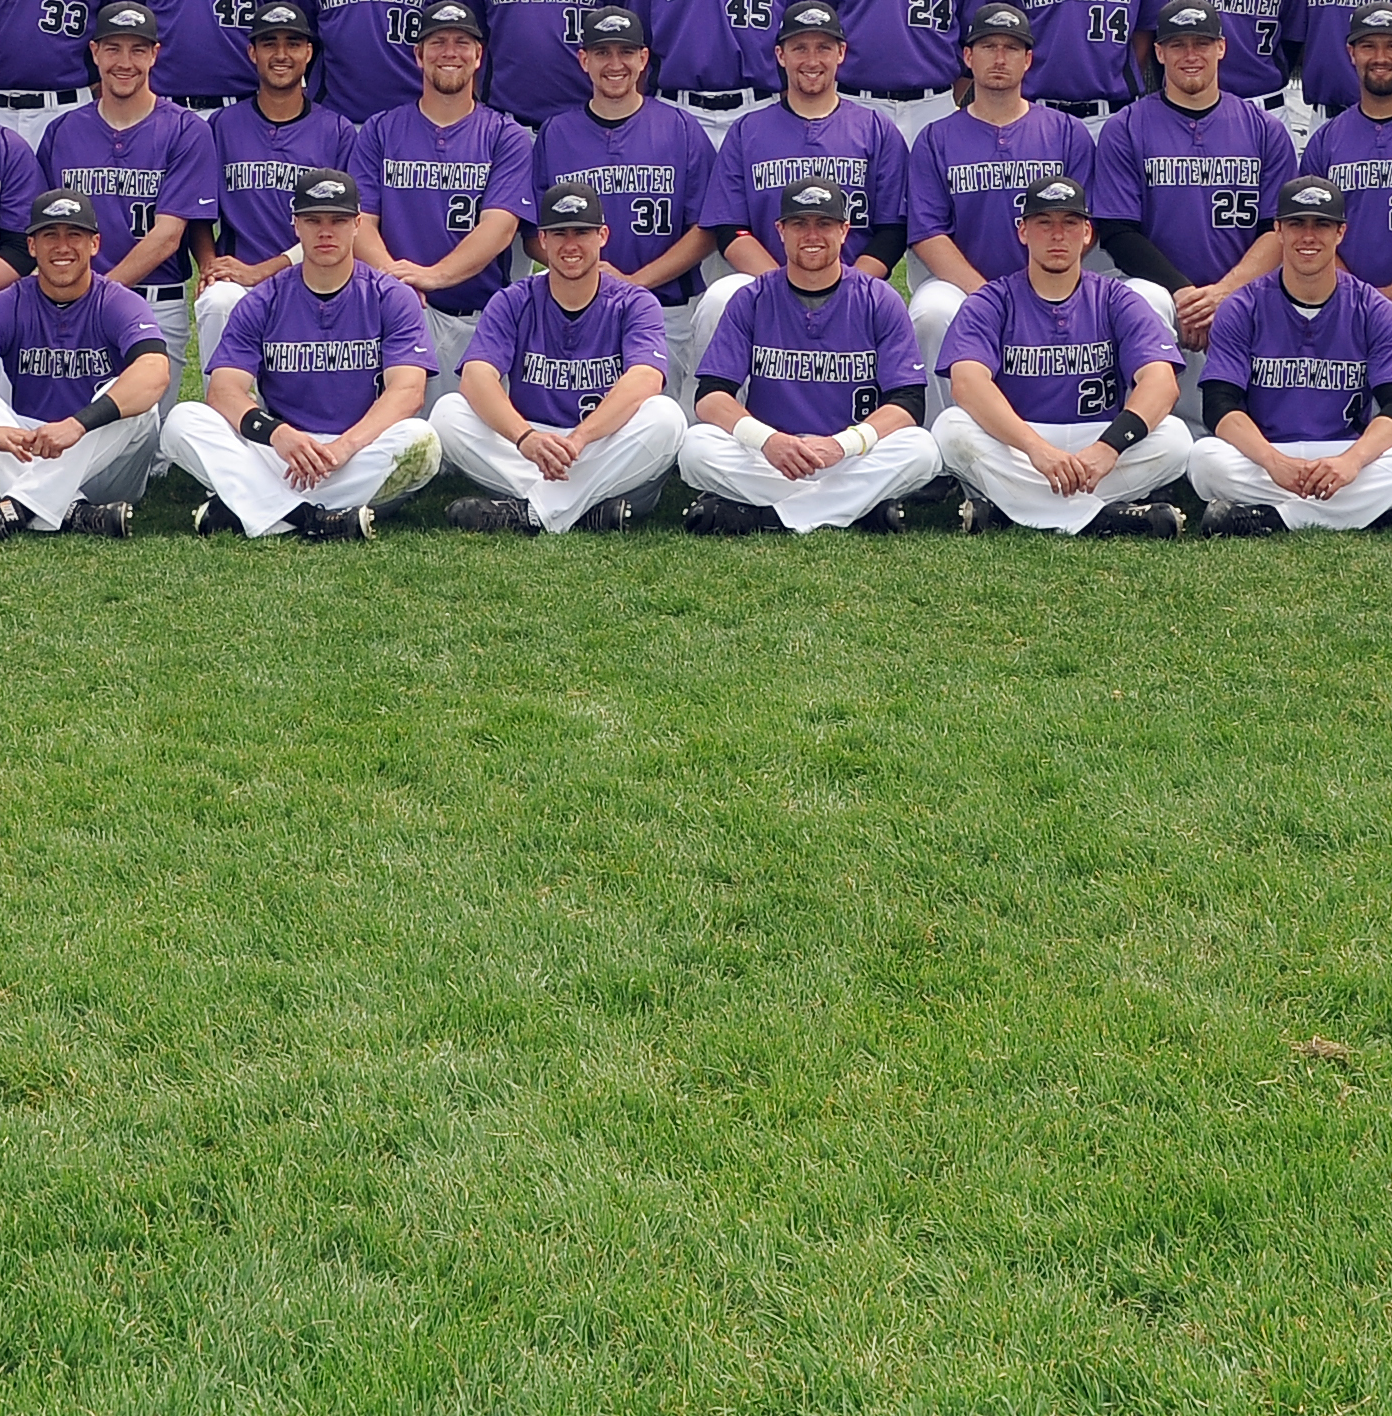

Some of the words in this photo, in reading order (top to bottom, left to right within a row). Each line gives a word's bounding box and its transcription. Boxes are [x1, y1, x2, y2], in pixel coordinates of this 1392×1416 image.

[1086, 4, 1129, 44] 14
[1255, 20, 1278, 55] 7
[1143, 157, 1262, 187] WHITEWATER
[631, 197, 672, 236] 31
[1211, 189, 1260, 229] 25
[751, 344, 878, 382] WHITEWATER
[1250, 355, 1368, 391] WHITEWATER
[851, 385, 879, 424] 8
[1077, 371, 1118, 416] 26
